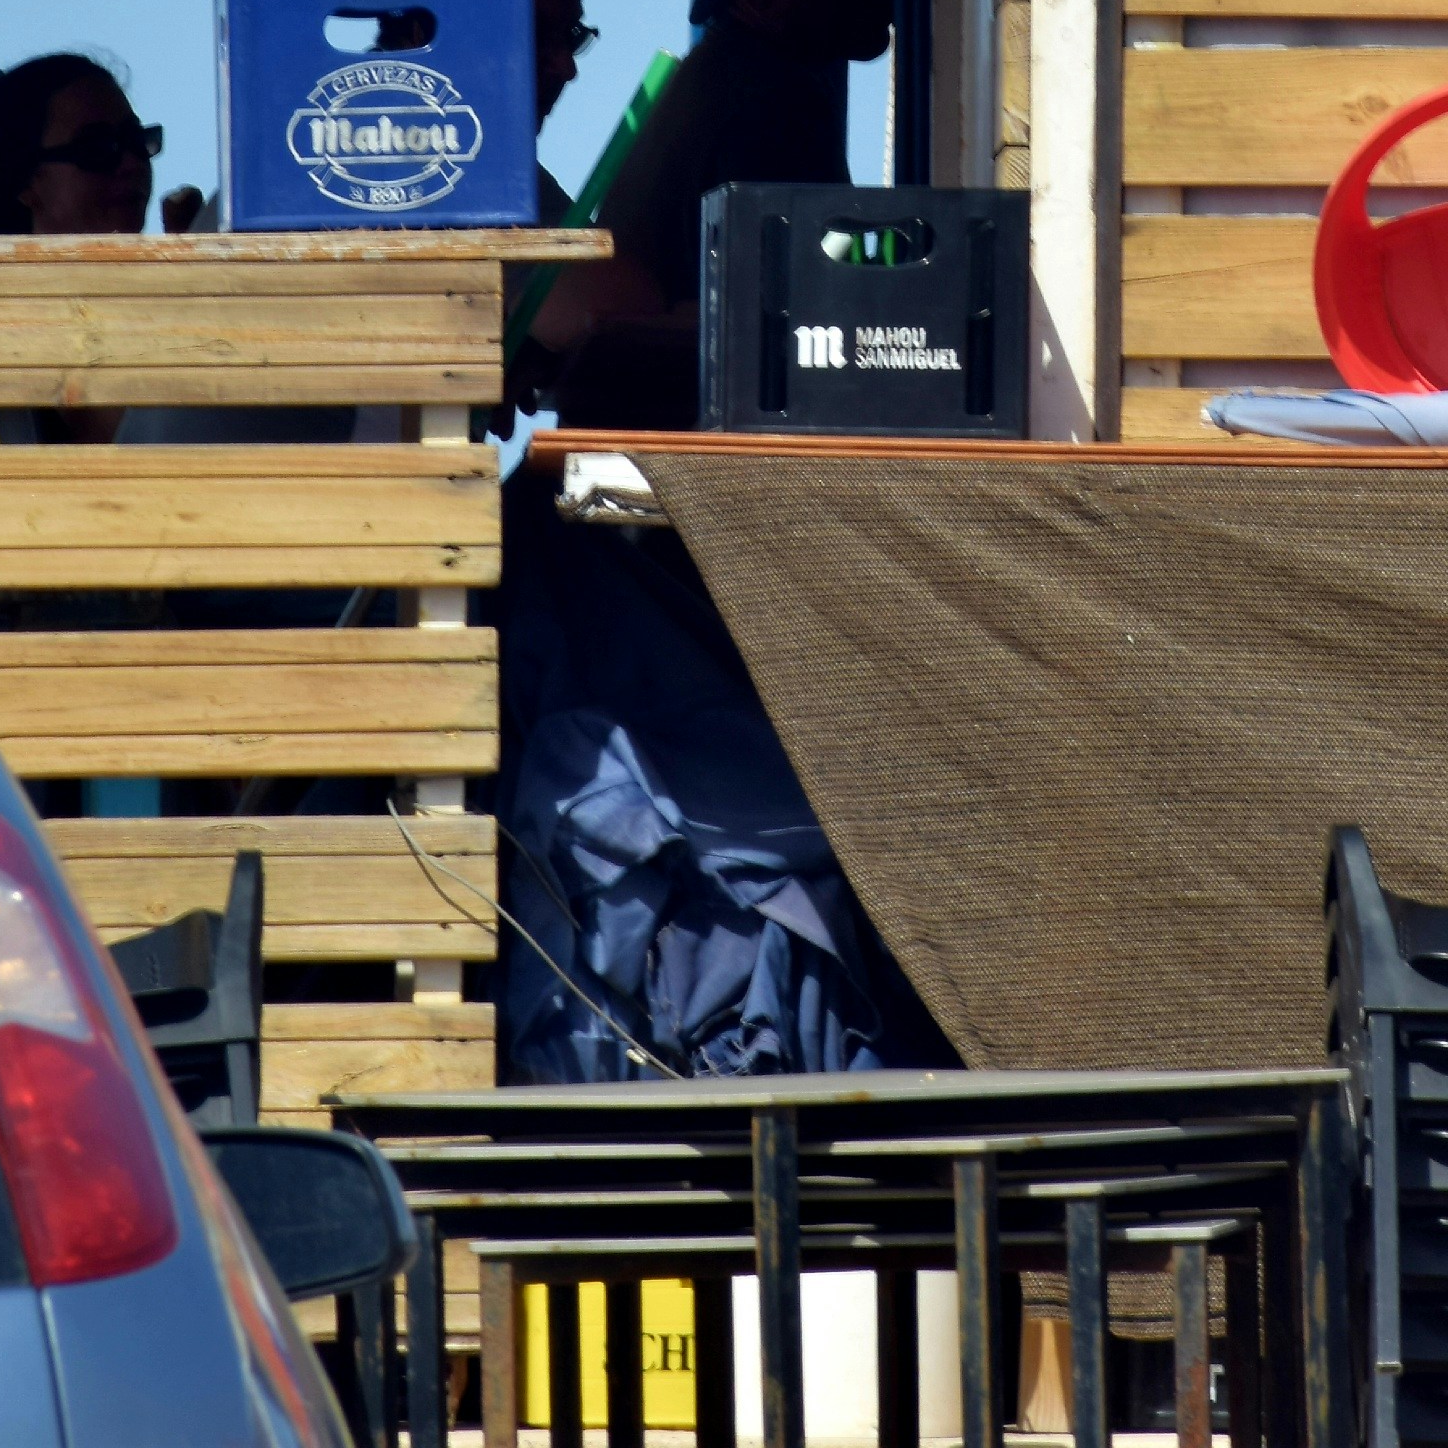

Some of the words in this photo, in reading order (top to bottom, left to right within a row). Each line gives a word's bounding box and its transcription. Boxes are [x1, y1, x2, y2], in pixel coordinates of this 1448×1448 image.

[331, 65, 438, 95] CERVEZAS
[309, 115, 462, 154] Mahou
[855, 326, 927, 348] MAHOU
